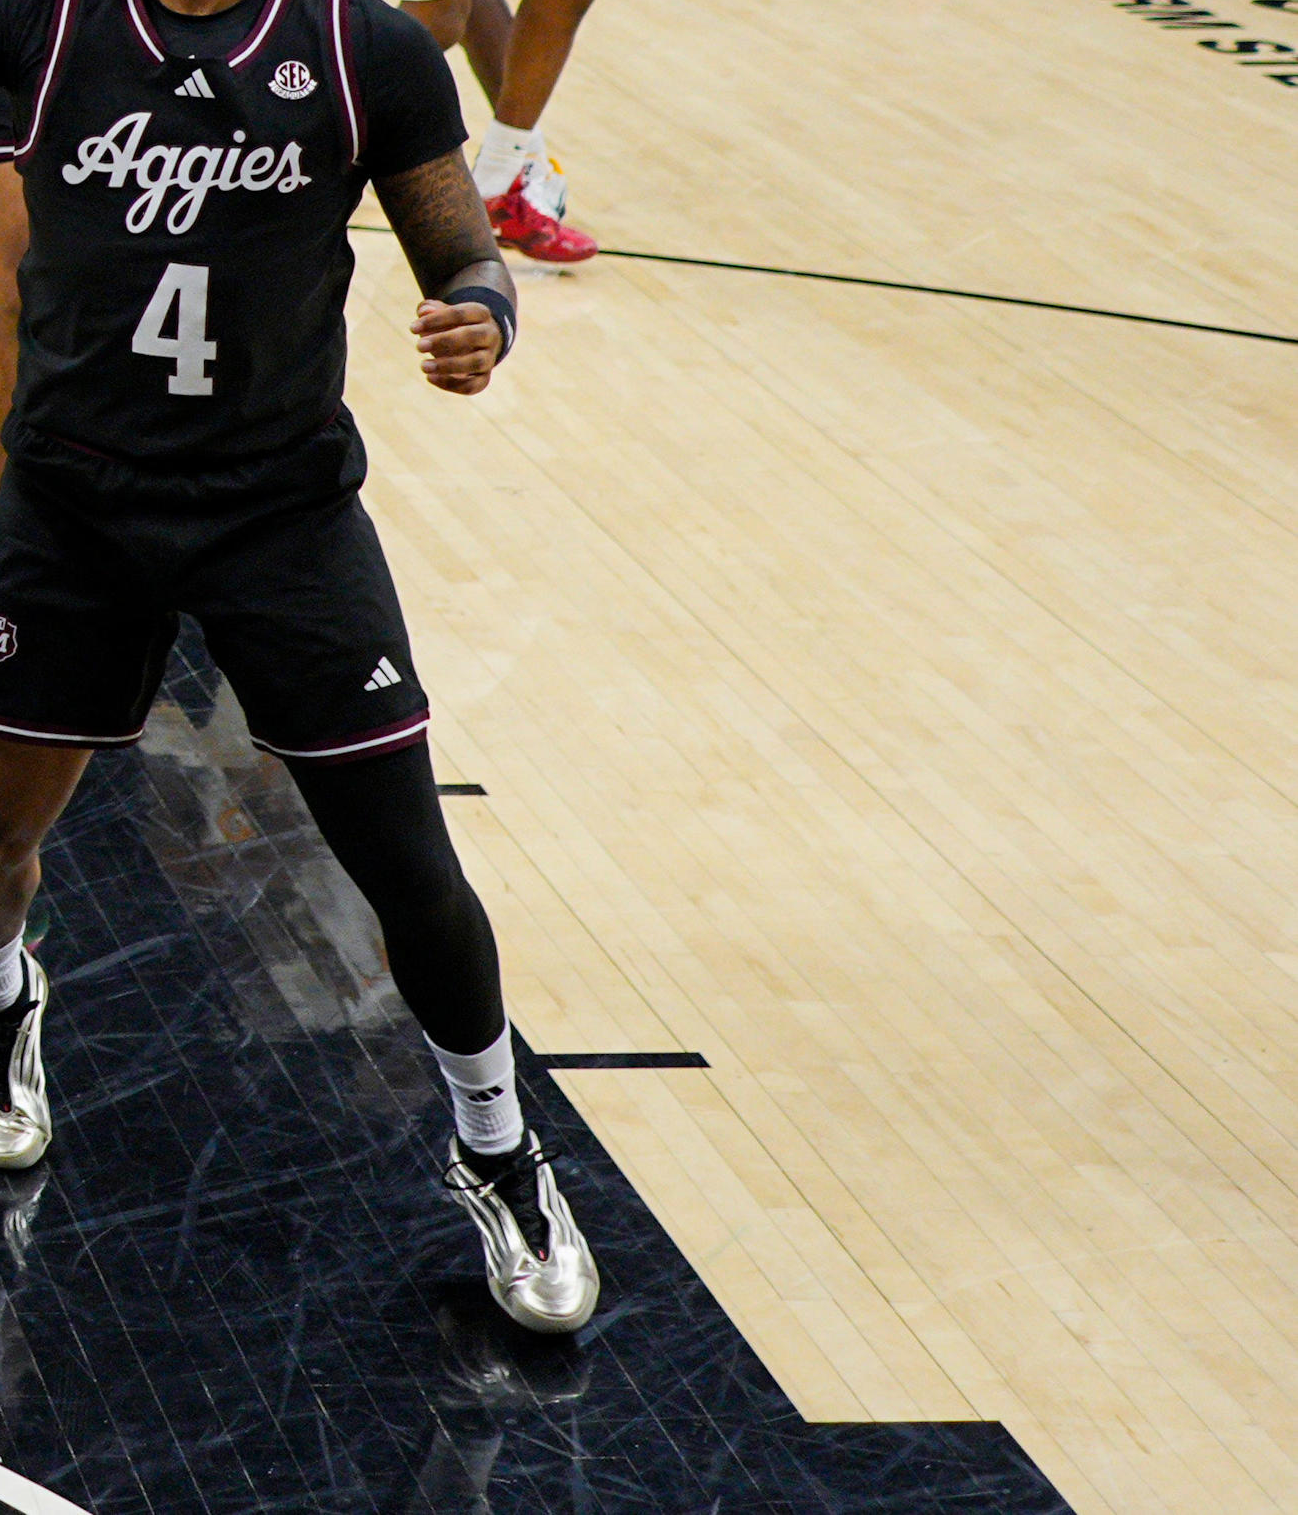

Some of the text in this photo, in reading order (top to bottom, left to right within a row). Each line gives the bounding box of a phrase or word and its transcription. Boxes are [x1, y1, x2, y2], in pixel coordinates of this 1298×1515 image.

[277, 61, 308, 90] SEC
[61, 111, 313, 235] Aggies
[131, 262, 217, 396] 4
